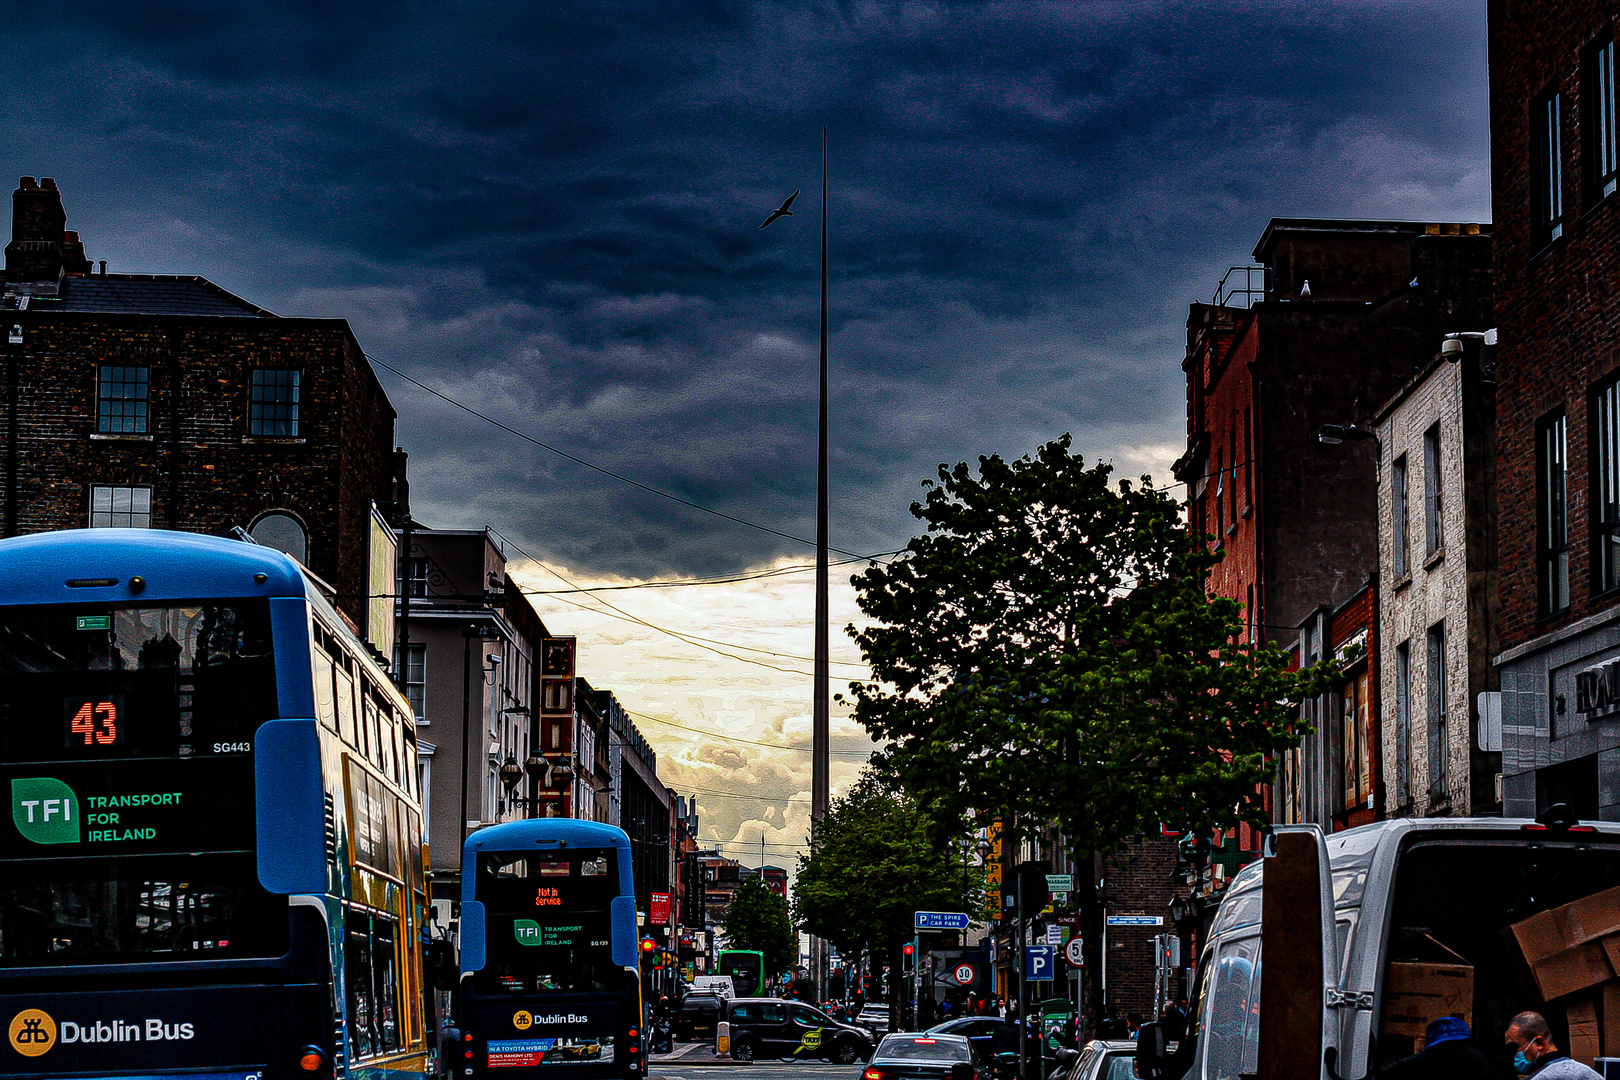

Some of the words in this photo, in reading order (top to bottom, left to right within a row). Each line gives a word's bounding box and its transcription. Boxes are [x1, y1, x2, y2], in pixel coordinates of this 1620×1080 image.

[71, 702, 117, 745] 43
[213, 743, 250, 753] SG443
[88, 792, 182, 808] TRANSPORT
[21, 798, 70, 823] TFI
[88, 813, 119, 825] FOR
[88, 828, 156, 842] IRELAND
[538, 888, 550, 897] Not
[551, 887, 558, 897] in
[535, 896, 561, 906] Service
[920, 915, 927, 924] P
[518, 927, 538, 938] TFI
[1033, 957, 1045, 974] P
[959, 969, 969, 978] 30
[534, 1014, 566, 1024] Dublin
[568, 1014, 588, 1023] Bus
[61, 1020, 140, 1043] Dublin
[145, 1019, 194, 1041] Bus
